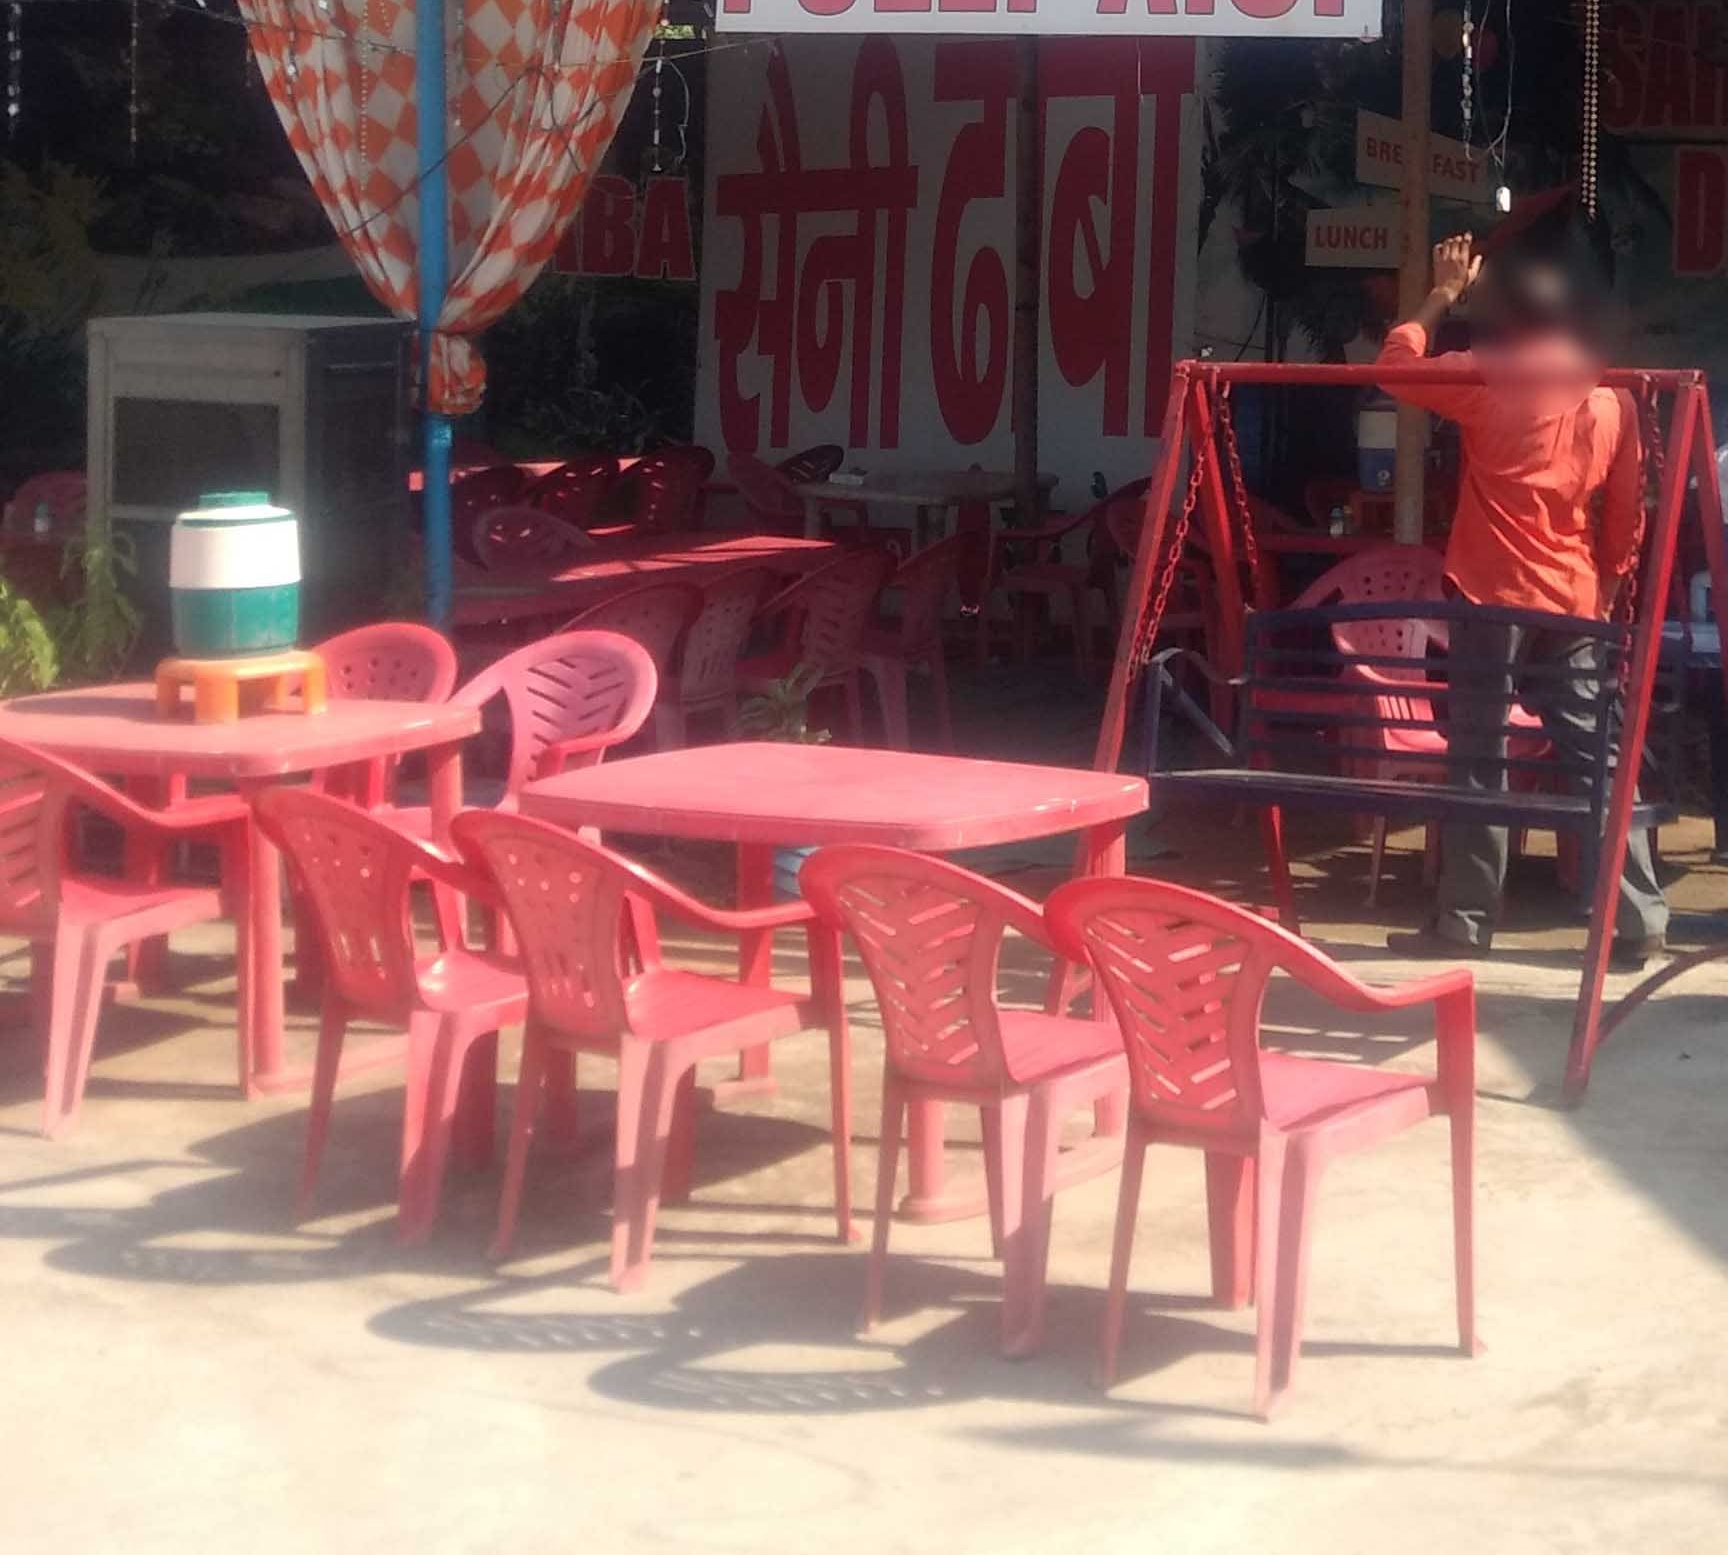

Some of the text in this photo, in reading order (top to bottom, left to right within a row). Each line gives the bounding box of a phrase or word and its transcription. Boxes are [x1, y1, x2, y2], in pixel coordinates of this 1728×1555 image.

[1366, 136, 1481, 184] BREFAST
[714, 36, 918, 454] सैनी
[1315, 224, 1389, 249] LUNCH
